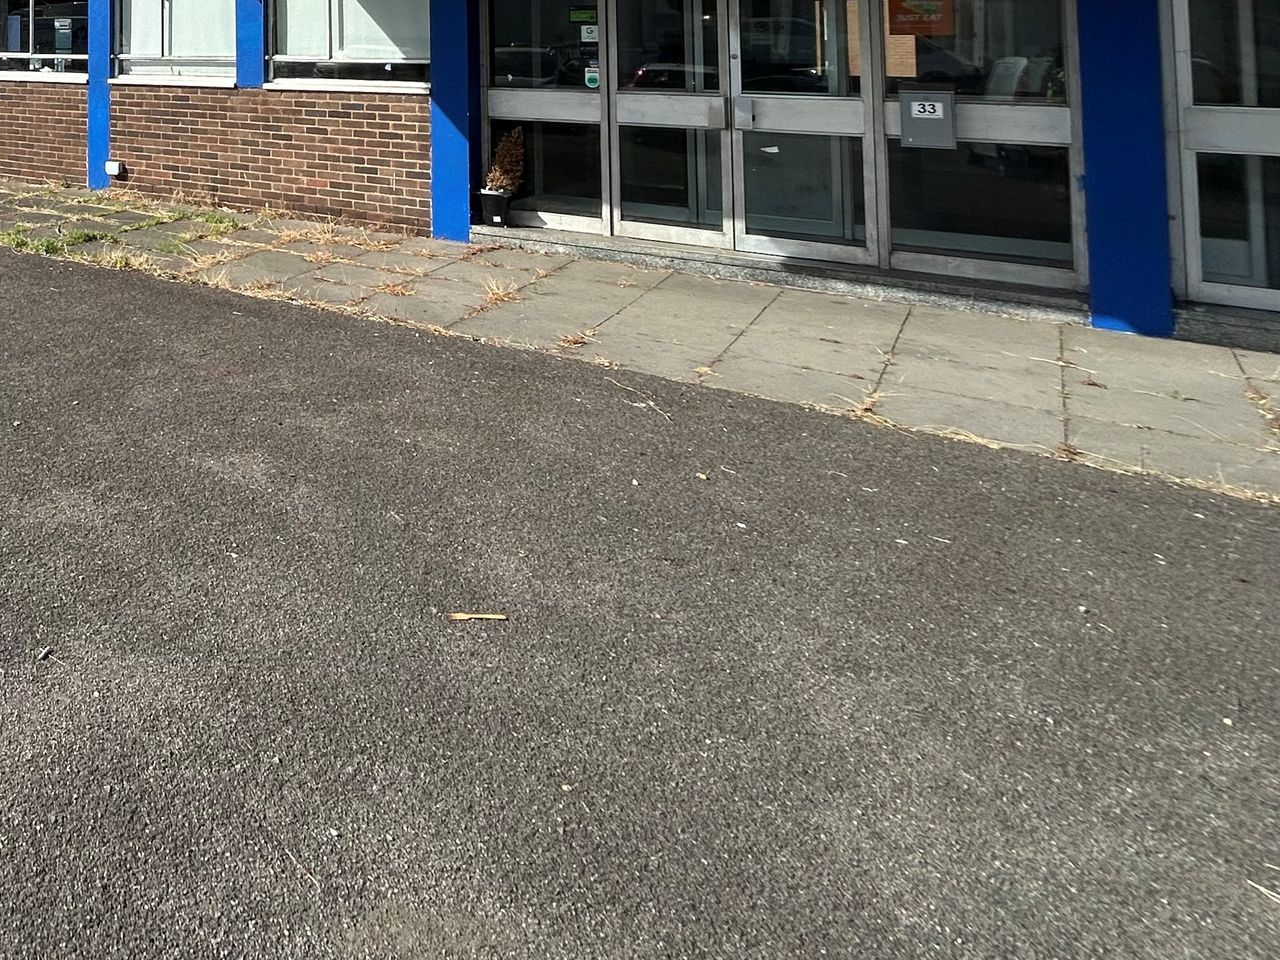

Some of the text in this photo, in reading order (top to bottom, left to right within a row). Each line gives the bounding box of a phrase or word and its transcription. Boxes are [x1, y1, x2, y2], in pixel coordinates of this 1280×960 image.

[896, 14, 943, 22] JUST EAT
[917, 103, 937, 114] 33
